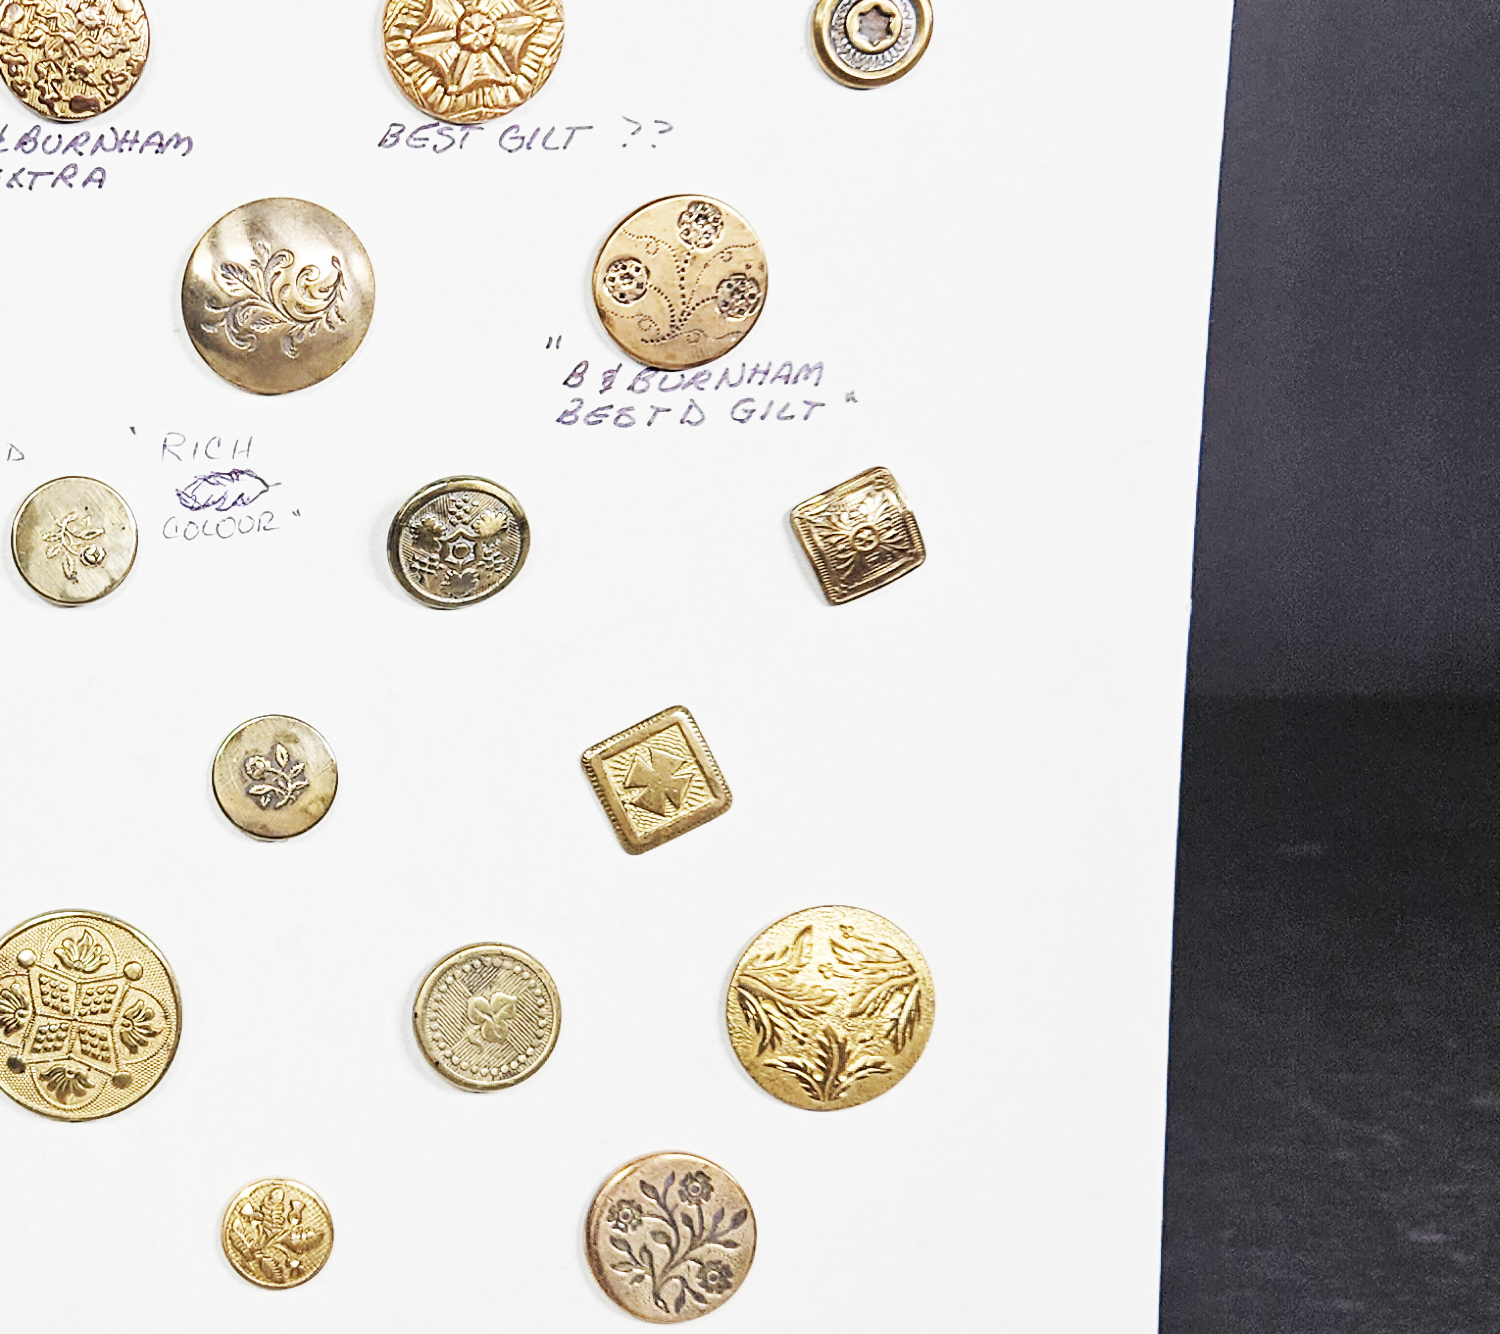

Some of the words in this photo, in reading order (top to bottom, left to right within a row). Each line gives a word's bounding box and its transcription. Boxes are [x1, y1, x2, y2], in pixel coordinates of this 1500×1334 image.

[377, 122, 485, 154] BEST
[498, 122, 594, 154] GILT
[626, 361, 825, 395] BURNHAM
